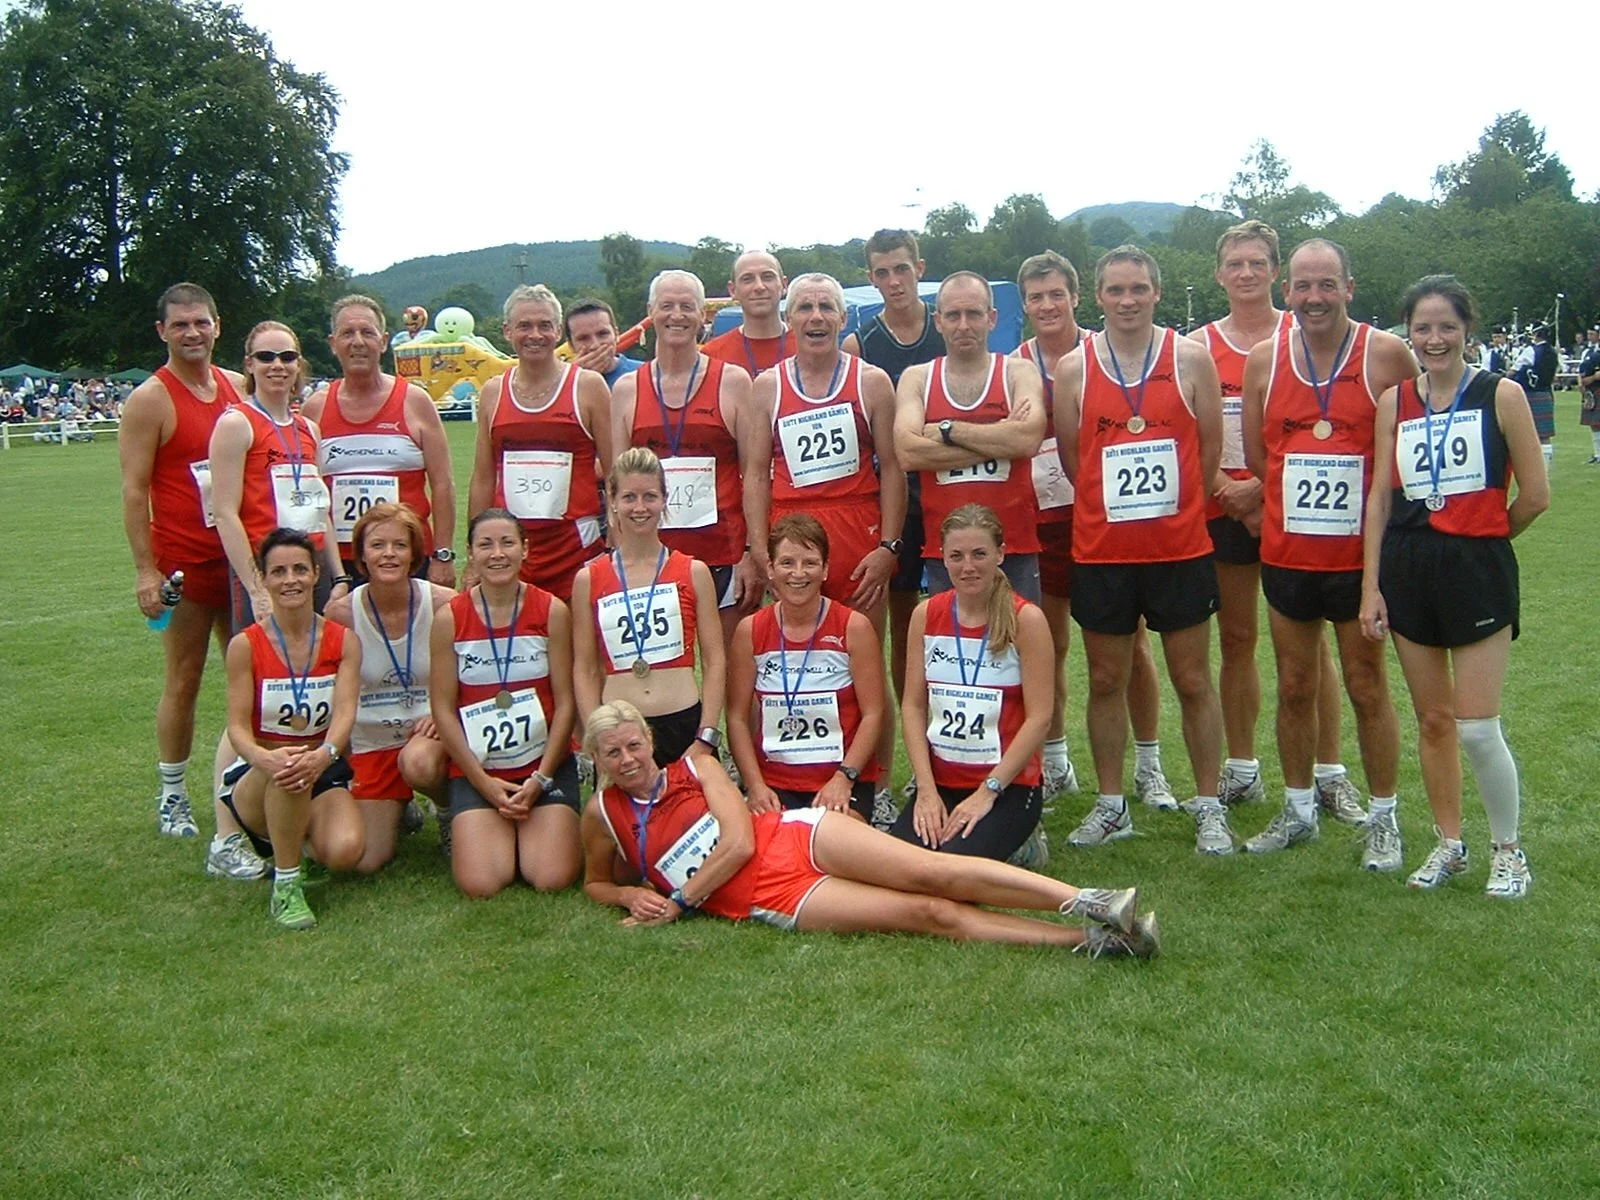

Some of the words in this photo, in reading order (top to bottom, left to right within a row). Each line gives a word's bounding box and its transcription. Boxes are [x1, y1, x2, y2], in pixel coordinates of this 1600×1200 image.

[798, 412, 828, 424] HIGHLAND
[828, 407, 849, 418] GAMES
[798, 427, 846, 462] 225
[1120, 446, 1151, 456] HIGHLAND
[1152, 444, 1173, 453] GAMES
[1413, 436, 1468, 473] 219
[1288, 458, 1303, 466] BUTE
[1304, 459, 1337, 467] HIGHLAND
[1338, 460, 1359, 468] GAMES
[514, 478, 553, 494] 350
[1117, 465, 1167, 497] 223
[668, 484, 694, 510] 48
[1296, 479, 1349, 510] 222
[617, 608, 669, 644] 235
[811, 697, 833, 705] GAMES
[946, 689, 974, 699] HIGHLAND
[975, 691, 998, 701] GAMES
[278, 701, 329, 727] 202
[940, 709, 985, 740] 224
[483, 715, 531, 753] 227
[778, 717, 829, 742] 226
[673, 832, 700, 859] HIGHLAND
